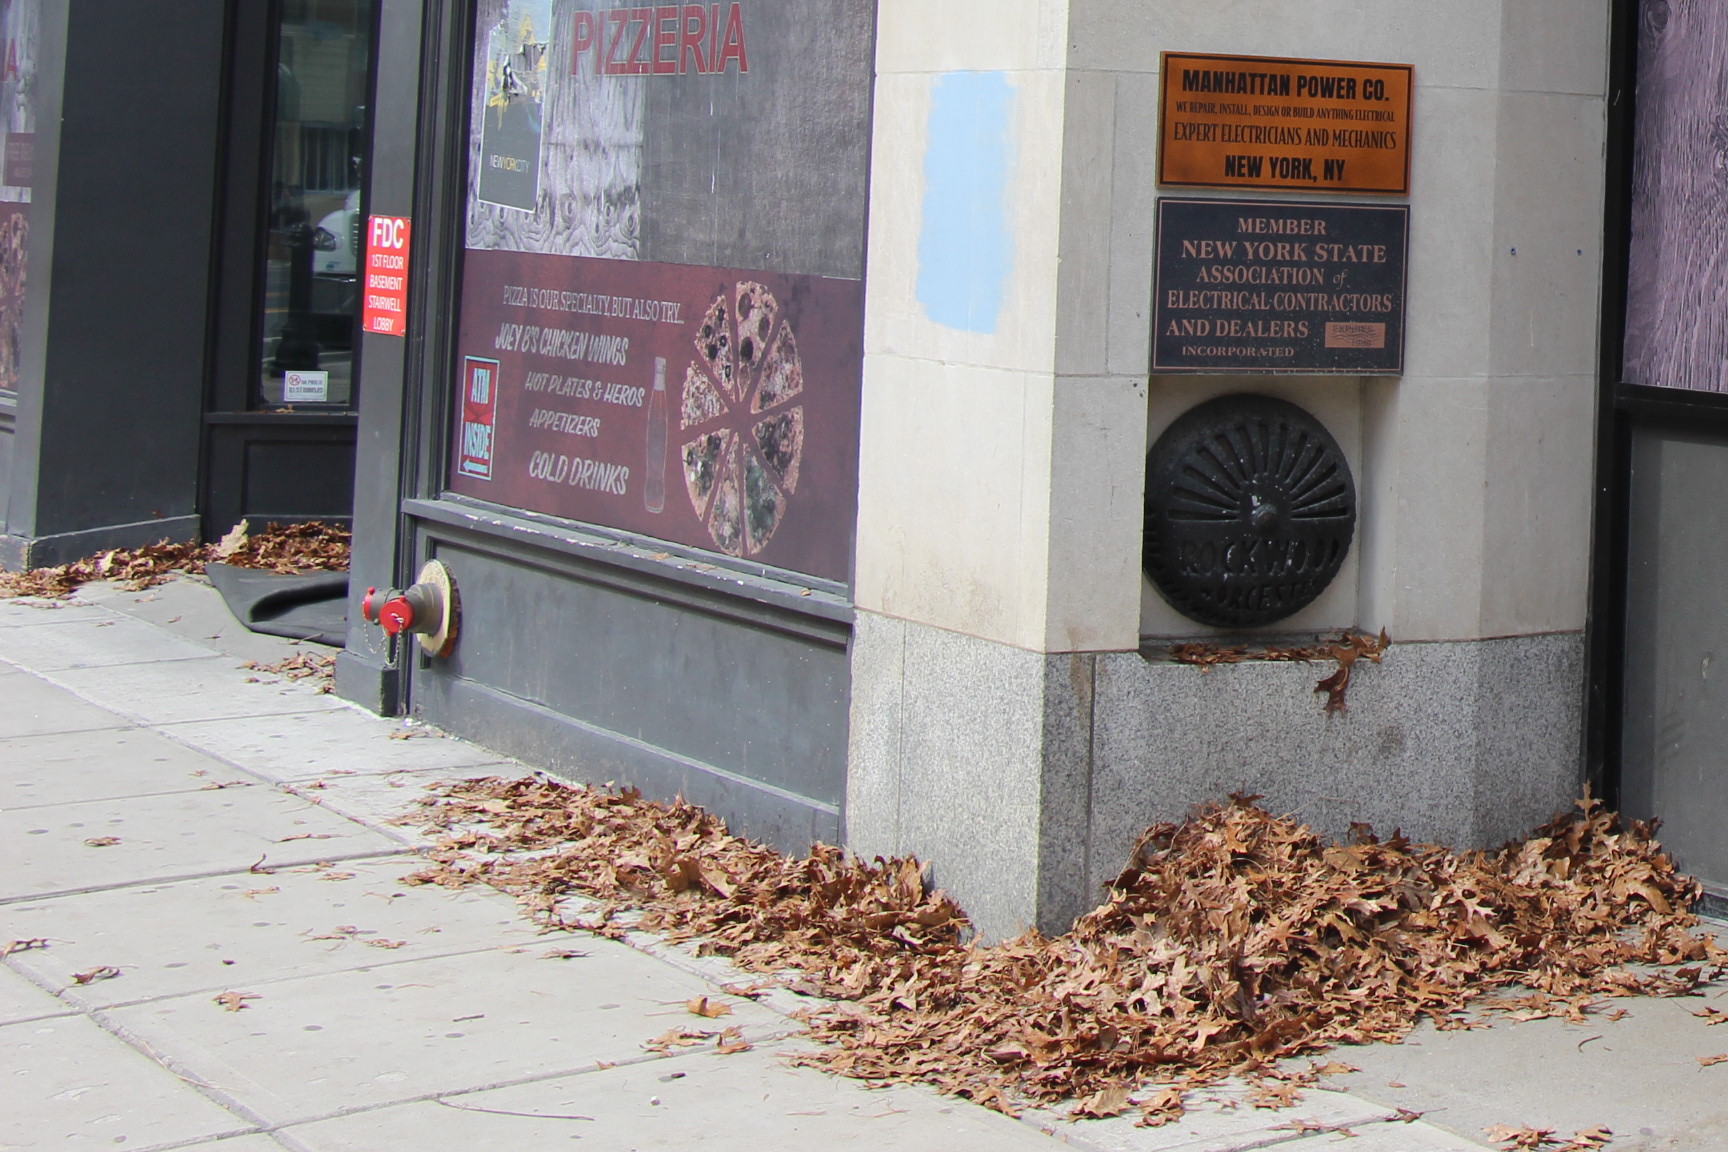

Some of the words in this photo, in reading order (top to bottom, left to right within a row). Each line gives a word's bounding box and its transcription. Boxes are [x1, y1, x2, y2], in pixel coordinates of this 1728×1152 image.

[571, 2, 748, 76] PIZZERIA
[1182, 70, 1290, 96] MANHATTAN
[1296, 75, 1356, 100] POWER
[1362, 79, 1390, 101] CO.
[1176, 101, 1188, 111] WE
[1189, 102, 1217, 114] REPAIR,
[1219, 104, 1251, 116] INSTALL,
[1253, 105, 1279, 117] DESIGN
[1281, 107, 1292, 117] OR
[1293, 107, 1314, 119] BUILD
[1316, 108, 1354, 120] ANYTHING
[1355, 110, 1395, 122] ELECTRICAL
[1174, 122, 1218, 142] EXPERT
[1221, 125, 1301, 146] ELECTRICIANS
[1305, 129, 1329, 147] AND
[1333, 130, 1396, 149] MECHANICS
[1225, 155, 1263, 177] NEW
[1269, 157, 1317, 182] YORK,
[1323, 160, 1345, 181] NY
[373, 218, 404, 248] FDC
[1238, 218, 1327, 235] MEMBER
[372, 255, 383, 267] 1ST
[383, 255, 403, 269] FLOOR
[1181, 240, 1237, 260] NEW
[1243, 241, 1308, 261] YORK
[1315, 244, 1387, 263] STATE
[370, 275, 403, 290] BASEMENT
[1196, 265, 1324, 285] ASSOCIATION
[1333, 269, 1347, 289] of
[368, 295, 401, 312] STAIRWELL
[503, 285, 528, 307] PIZZA
[529, 288, 538, 308] IS
[539, 289, 559, 310] OUR
[560, 291, 610, 317] SPECIALTY,
[611, 297, 632, 318] BUT
[633, 299, 659, 321] ALSO
[1168, 290, 1270, 310] ELECTRICAL
[1274, 292, 1392, 312] CONTRACTORS
[373, 317, 394, 331] LOBBY
[1166, 319, 1209, 337] AND
[1216, 320, 1309, 338] DEALERS
[495, 323, 523, 351] JOEY
[522, 326, 540, 353] B'S
[539, 328, 588, 360] CHICKEN
[588, 334, 629, 366] WINGS
[1182, 346, 1295, 357] INCORPORATED
[471, 368, 490, 404] ATM
[525, 371, 549, 391] HOT
[548, 374, 592, 399] PLATES
[592, 381, 603, 400] &
[604, 383, 645, 407] HEROS
[529, 408, 600, 438] APPETIZERS
[464, 422, 491, 458] INSIDE
[529, 451, 568, 483] COLD
[569, 458, 629, 495] DRINKS
